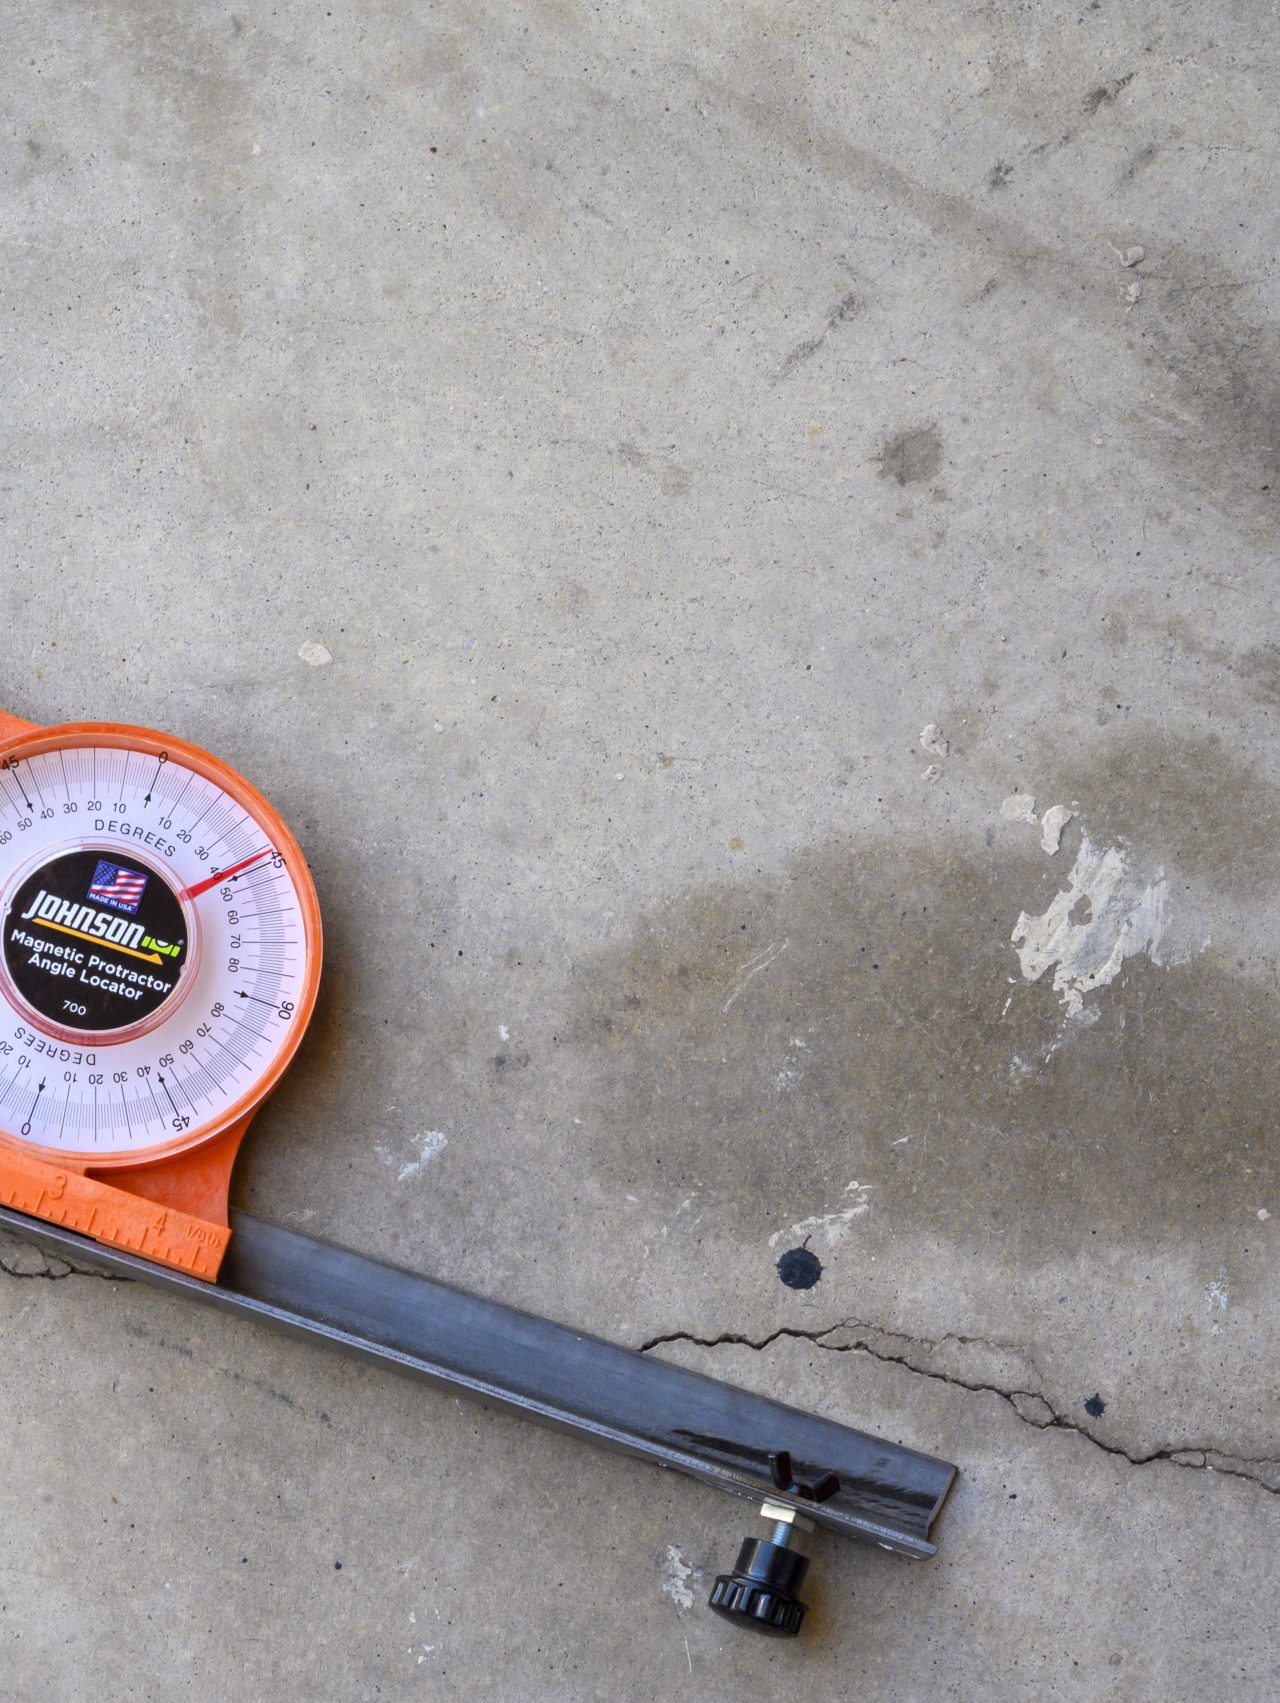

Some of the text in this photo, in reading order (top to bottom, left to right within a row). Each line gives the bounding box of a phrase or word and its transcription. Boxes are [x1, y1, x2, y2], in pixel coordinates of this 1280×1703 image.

[1, 755, 20, 771] 45
[158, 751, 169, 764] 0
[63, 802, 78, 814] 30
[87, 800, 102, 811] 20
[113, 803, 127, 814] 10
[40, 808, 55, 820] 40
[17, 817, 33, 832] 50
[158, 816, 172, 830] 10
[94, 818, 176, 857] DEGREES
[176, 829, 192, 844] 20
[194, 846, 210, 861] 30
[271, 851, 287, 869] 45
[210, 866, 223, 881] 40
[89, 892, 132, 912] MADE IN USA
[220, 887, 233, 902] 50
[21, 890, 146, 950] JOHNSON
[227, 910, 240, 925] 60
[230, 934, 241, 949] 70
[11, 929, 172, 994] Magnetic Protractor
[227, 957, 240, 973] 80
[27, 953, 144, 1001] Angle Locator
[62, 1000, 87, 1016] 700
[210, 1002, 225, 1018] 80
[278, 1000, 295, 1021] 90
[196, 1022, 212, 1038] 70
[14, 1026, 96, 1066] DEGREES
[178, 1039, 195, 1055] 60
[17, 1054, 32, 1069] 10
[158, 1053, 175, 1068] 50
[63, 1071, 78, 1084] 10
[88, 1073, 104, 1085] 20
[112, 1071, 128, 1084] 30
[136, 1065, 152, 1078] 40
[21, 1122, 32, 1136] 0
[172, 1115, 191, 1132] 45
[48, 1174, 67, 1200] 3
[153, 1211, 168, 1237] 4
